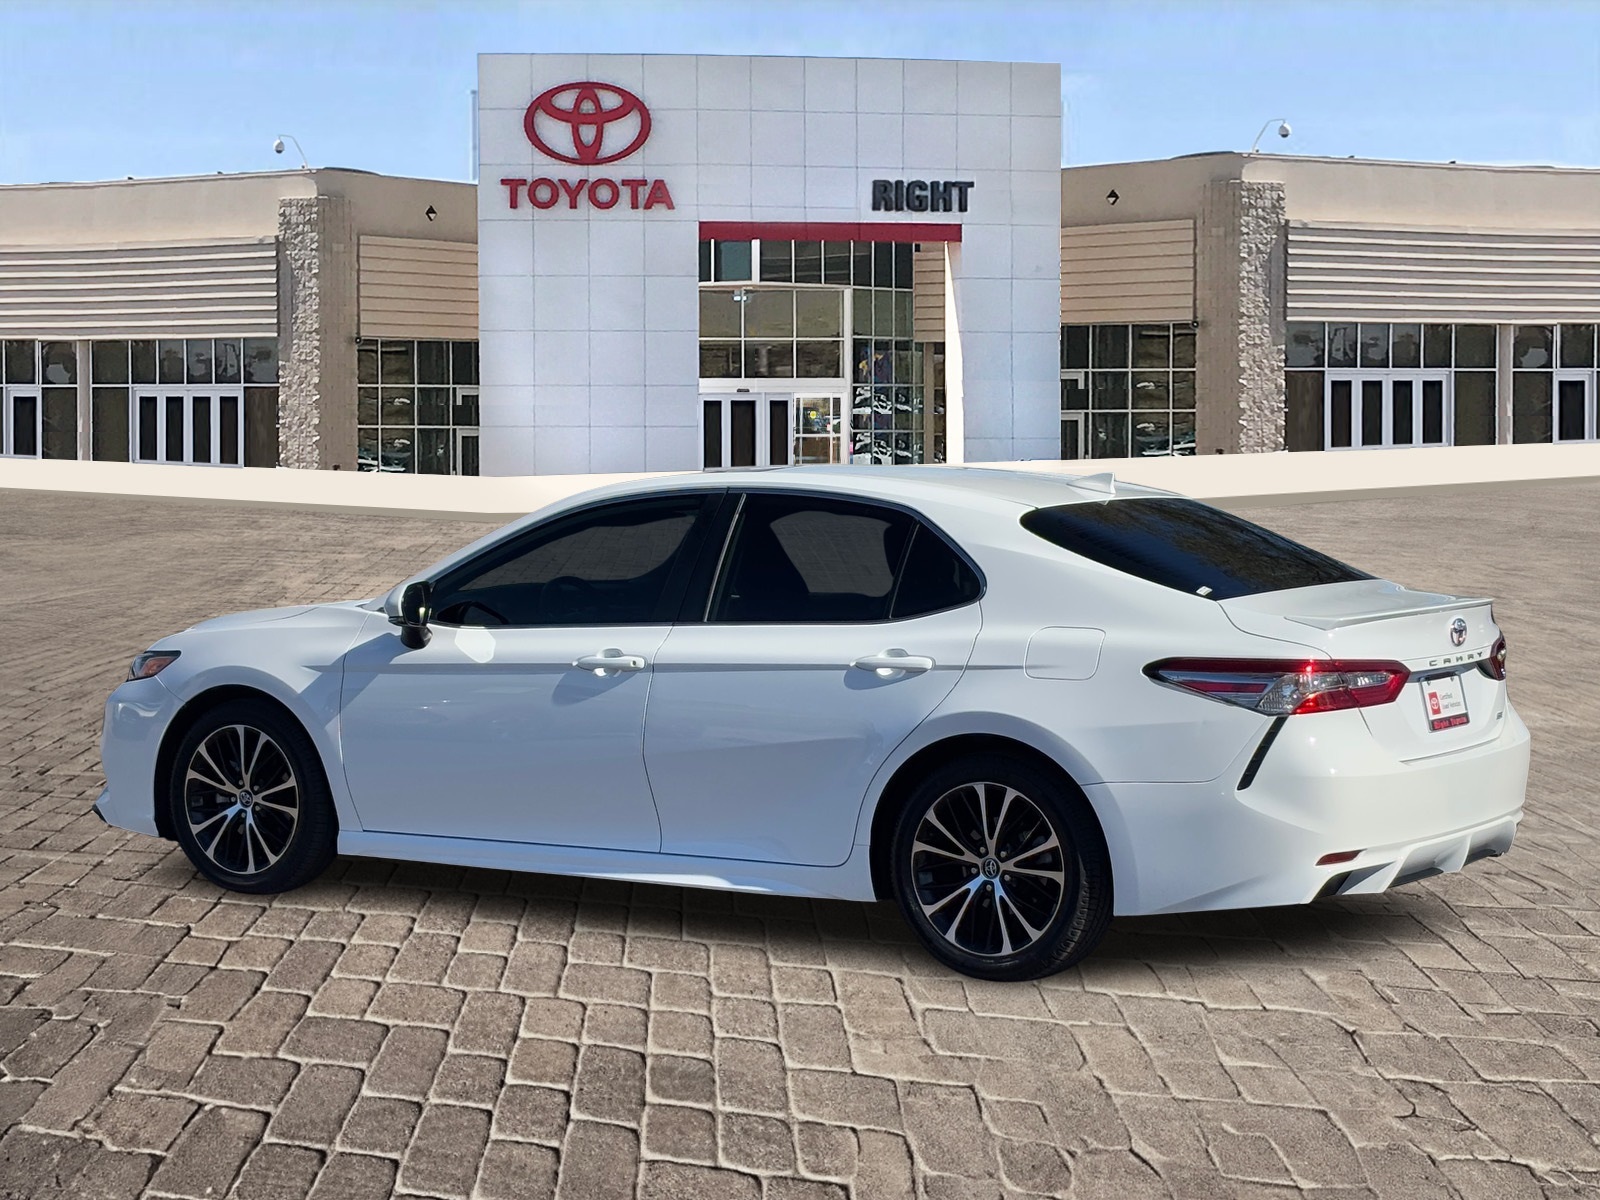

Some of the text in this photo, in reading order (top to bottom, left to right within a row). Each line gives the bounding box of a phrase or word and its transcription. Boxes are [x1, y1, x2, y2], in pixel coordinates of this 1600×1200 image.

[500, 178, 675, 210] TOYOTA
[872, 179, 975, 212] RIGHT
[1429, 652, 1483, 666] CAMRY
